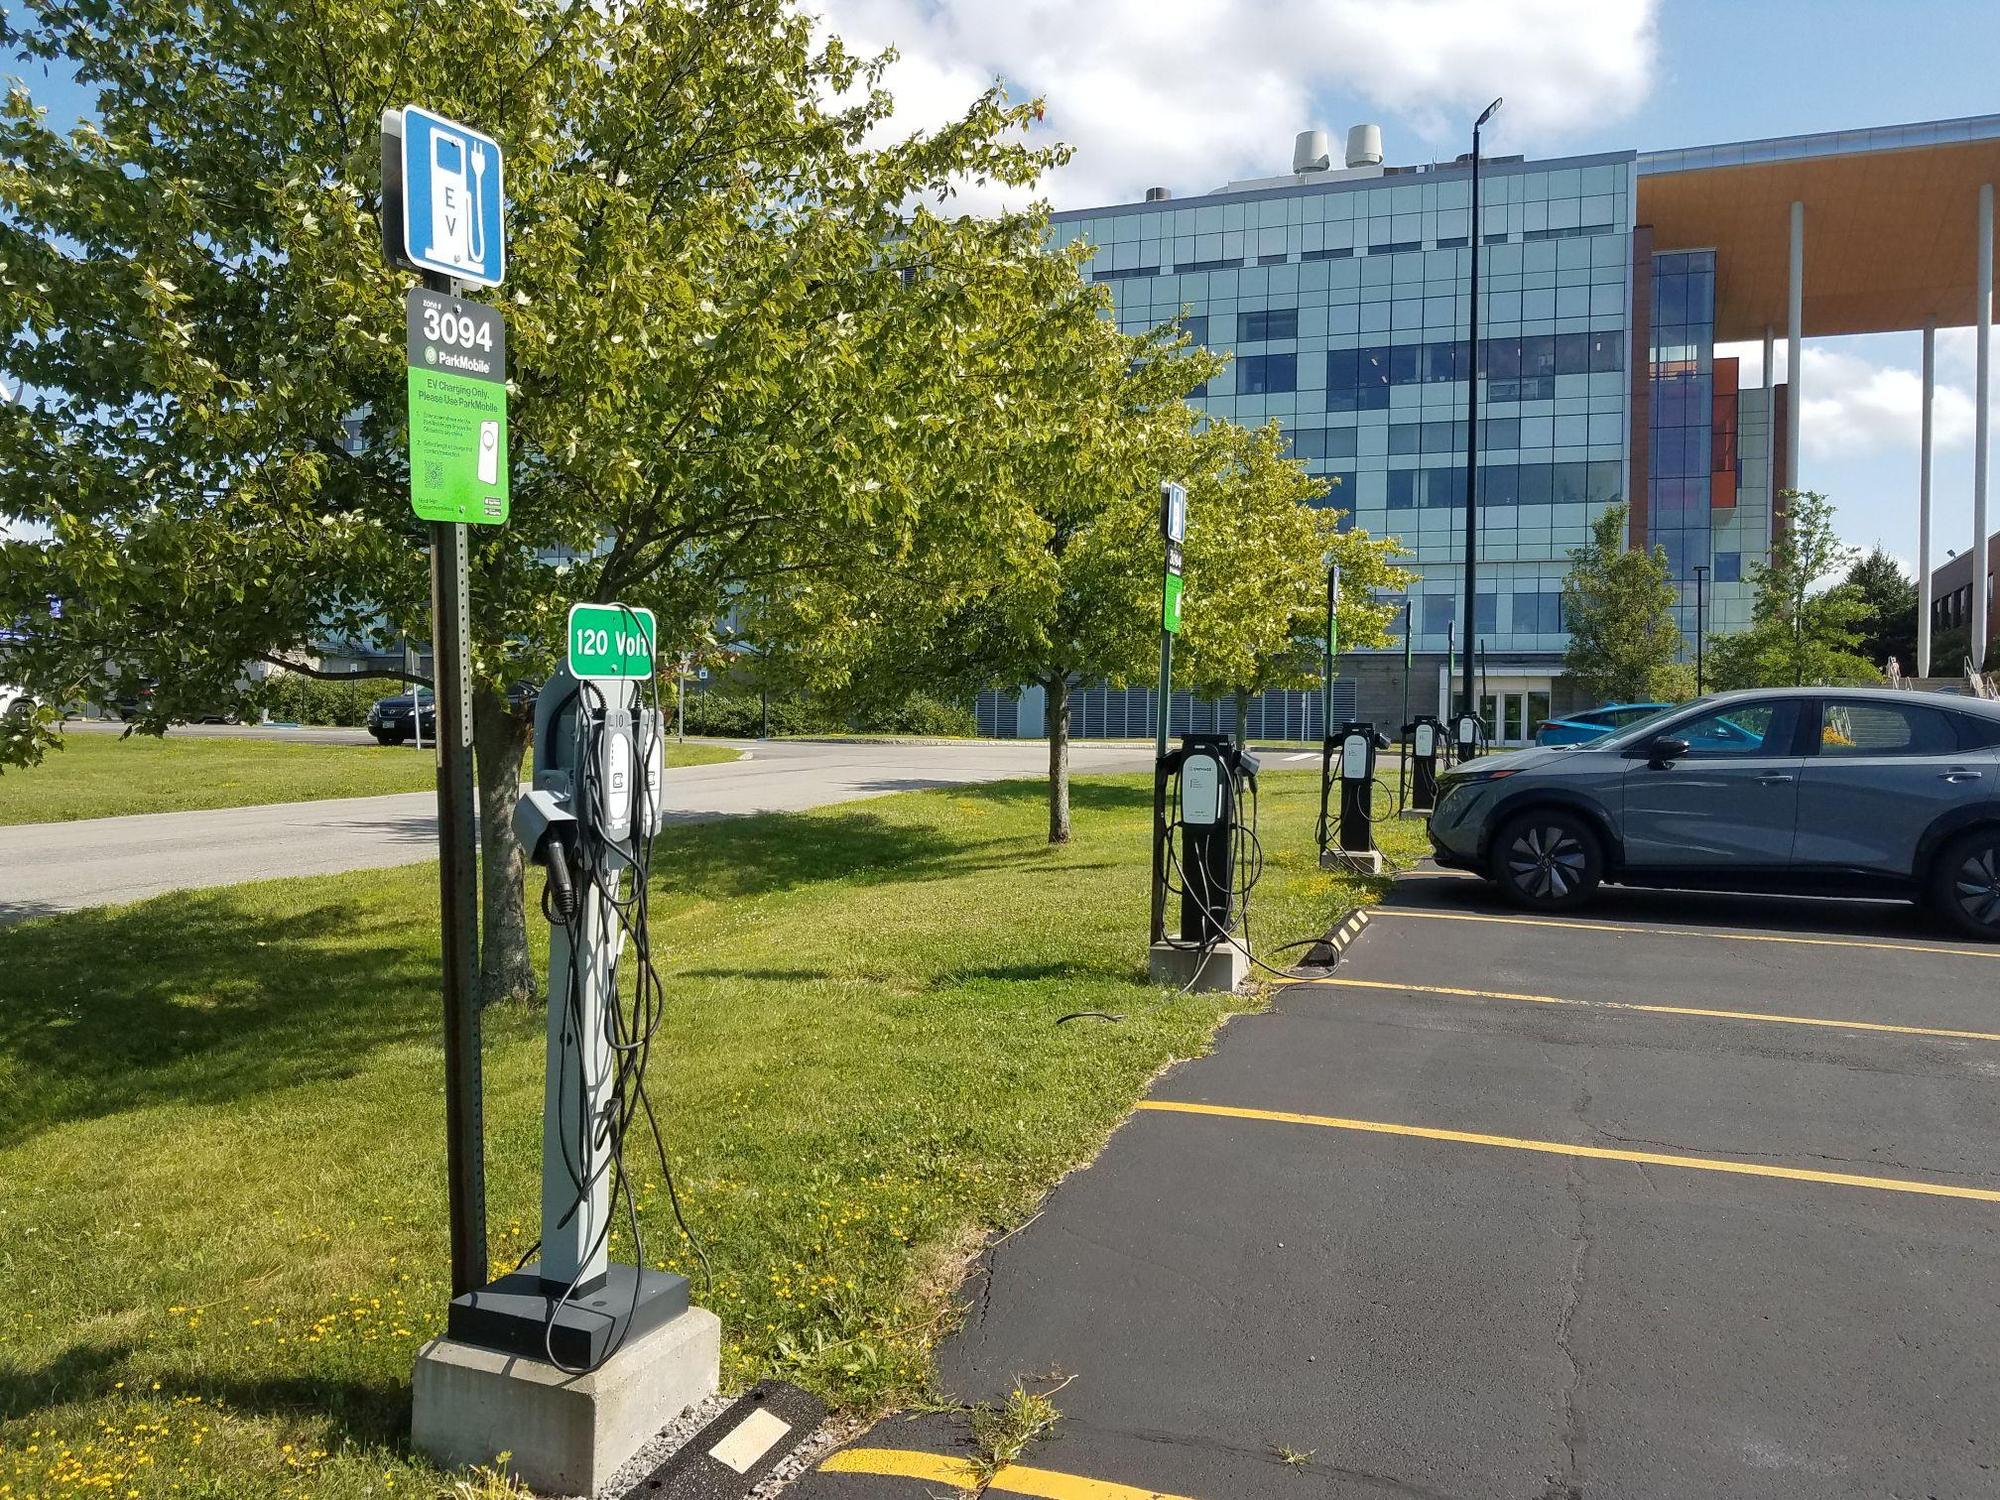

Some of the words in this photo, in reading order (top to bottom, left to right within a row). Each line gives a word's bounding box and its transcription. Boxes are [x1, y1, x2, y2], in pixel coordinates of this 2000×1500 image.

[423, 308, 493, 352] 3094
[439, 351, 490, 374] ParkMobile
[427, 379, 438, 389] EV
[439, 380, 471, 397] Charging
[418, 390, 443, 403] Please
[444, 395, 458, 406] Use
[459, 398, 498, 412] ParkMobile
[577, 629, 608, 655] 120
[615, 630, 649, 657] Volt
